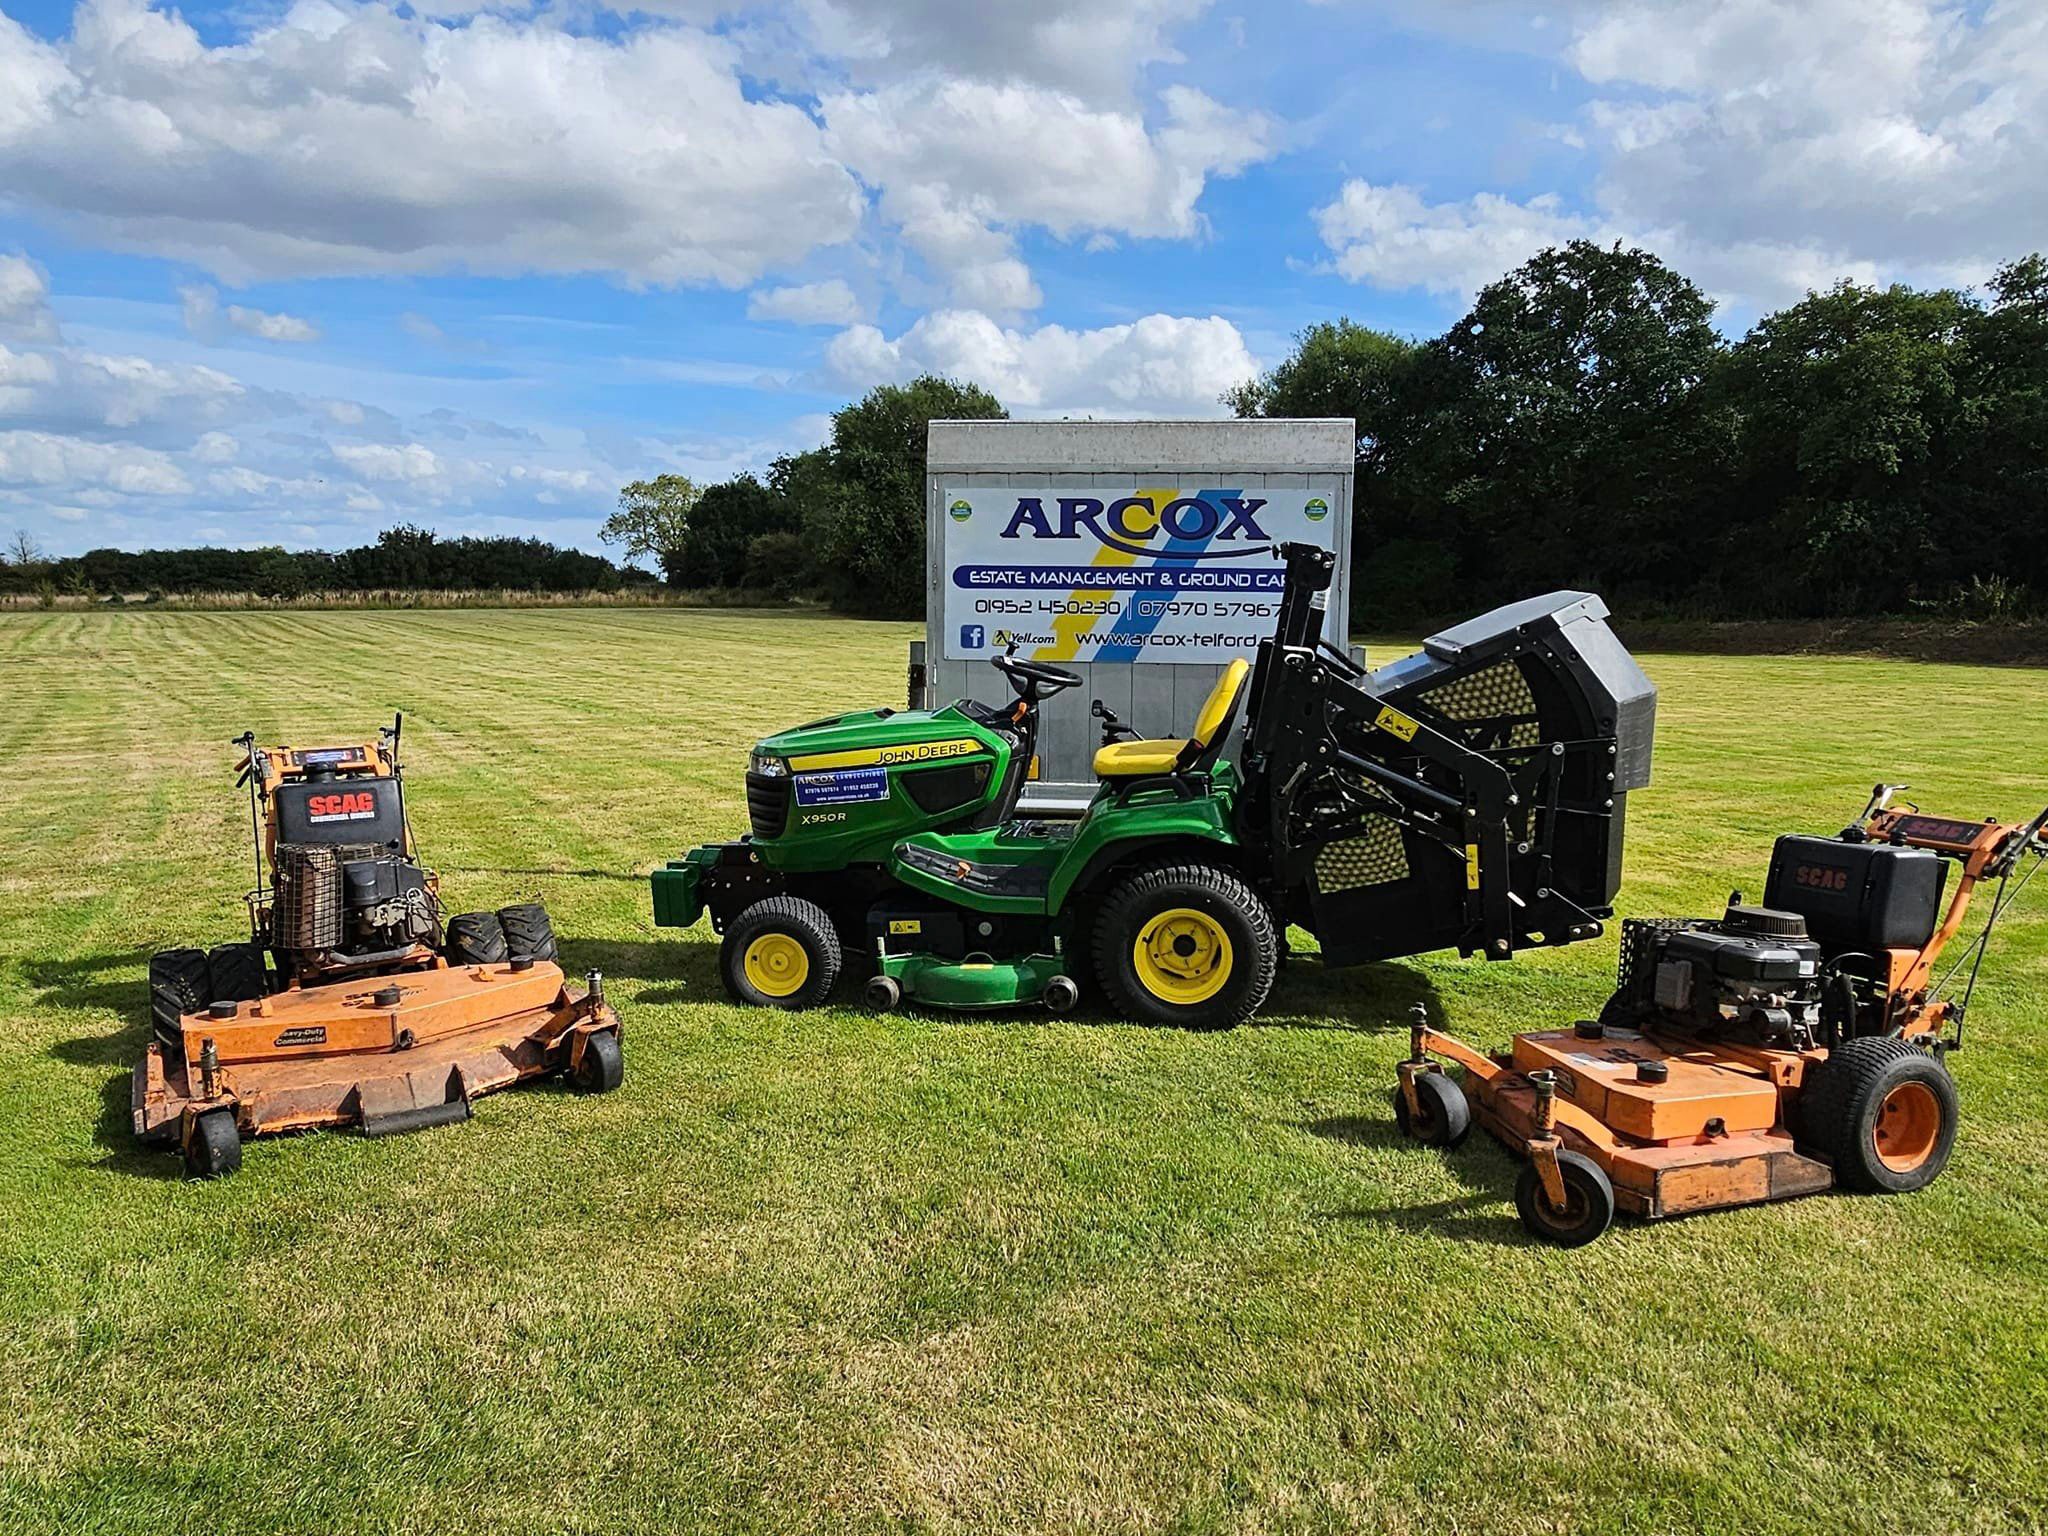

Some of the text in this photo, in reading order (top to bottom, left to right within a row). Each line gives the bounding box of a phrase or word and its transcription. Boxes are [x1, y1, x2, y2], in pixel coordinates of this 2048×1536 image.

[1000, 497, 1272, 559] ARCOX
[969, 570, 1026, 584] ESTATE
[1030, 571, 1155, 586] MANAGEMENT
[1159, 572, 1174, 586] &
[1179, 573, 1251, 587] GROUND
[975, 599, 1284, 618] 01952 450230 07970 57967
[1011, 632, 1056, 644] Yell.com
[875, 742, 968, 764] JOHN DEERE
[309, 792, 374, 815] SCAG
[801, 812, 847, 825] X950R
[1796, 865, 1847, 890] SCAG
